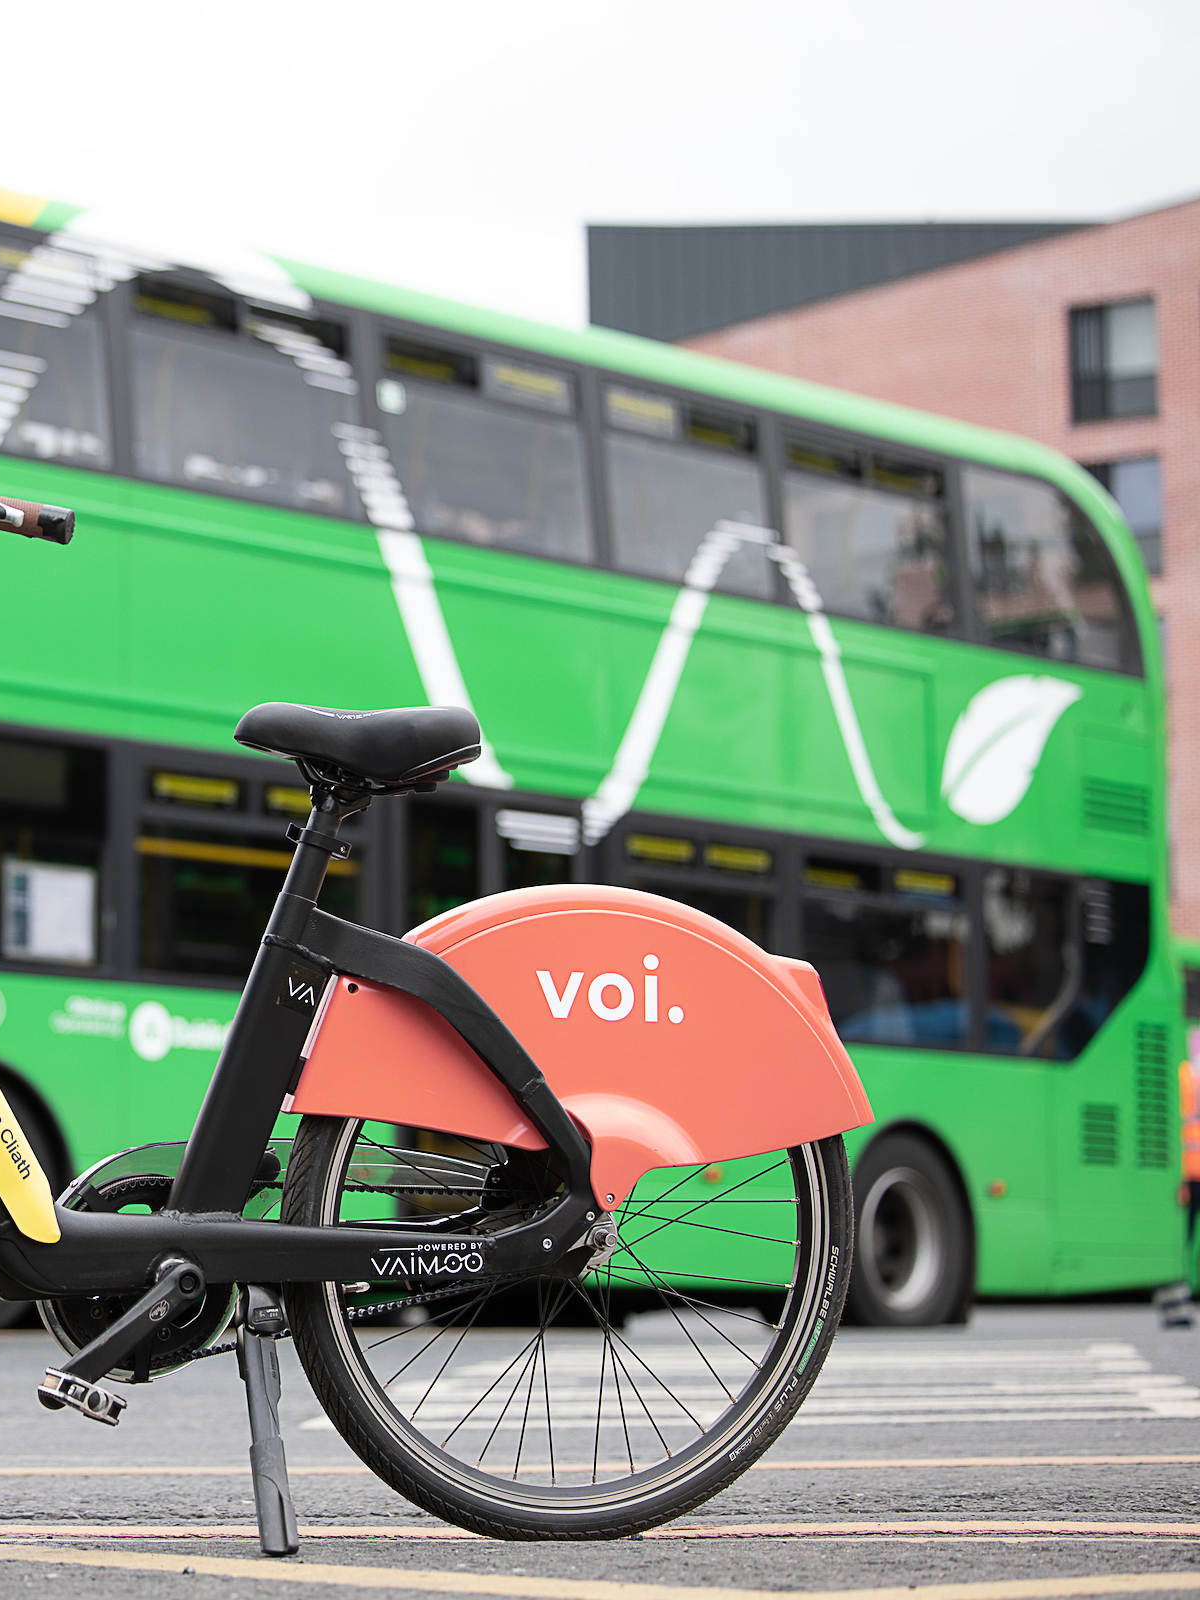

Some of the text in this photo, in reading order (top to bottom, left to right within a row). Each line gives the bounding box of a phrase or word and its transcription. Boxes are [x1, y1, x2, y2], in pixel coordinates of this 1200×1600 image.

[535, 953, 684, 1024] voi.
[0, 1128, 31, 1180] Cliath
[417, 1242, 483, 1252] POWERED BY
[819, 1245, 840, 1319] SCHWALBE
[774, 1376, 798, 1413] PLUS
